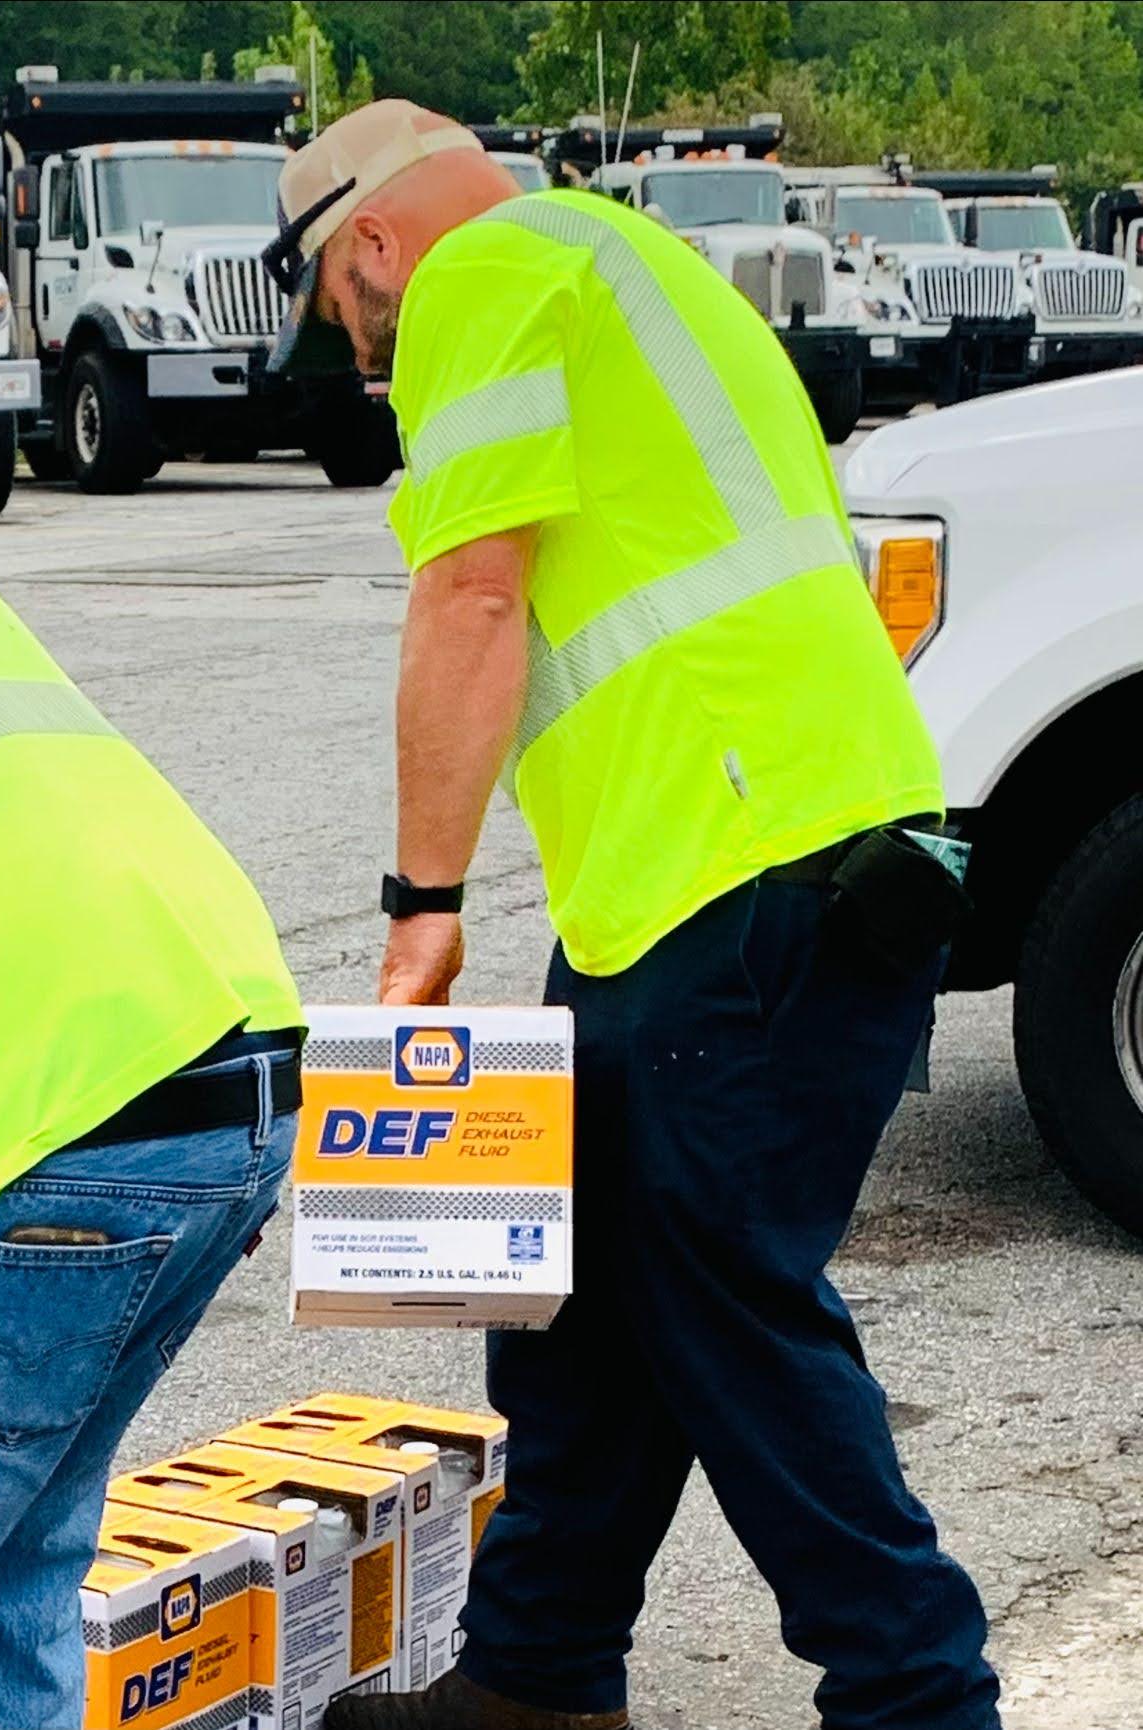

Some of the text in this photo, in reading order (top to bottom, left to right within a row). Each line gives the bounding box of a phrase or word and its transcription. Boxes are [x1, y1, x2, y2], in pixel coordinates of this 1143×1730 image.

[414, 1046, 450, 1066] NAPA
[466, 1111, 526, 1123] DIESEL
[318, 1109, 455, 1156] DEF
[461, 1128, 545, 1140] EXHAUST
[457, 1145, 510, 1157] FLUID
[340, 1268, 359, 1277] NET
[361, 1268, 416, 1278] CONTENTS:
[419, 1269, 434, 1279] 2.5
[437, 1270, 455, 1279] U.S.
[120, 1650, 194, 1722] DEF
